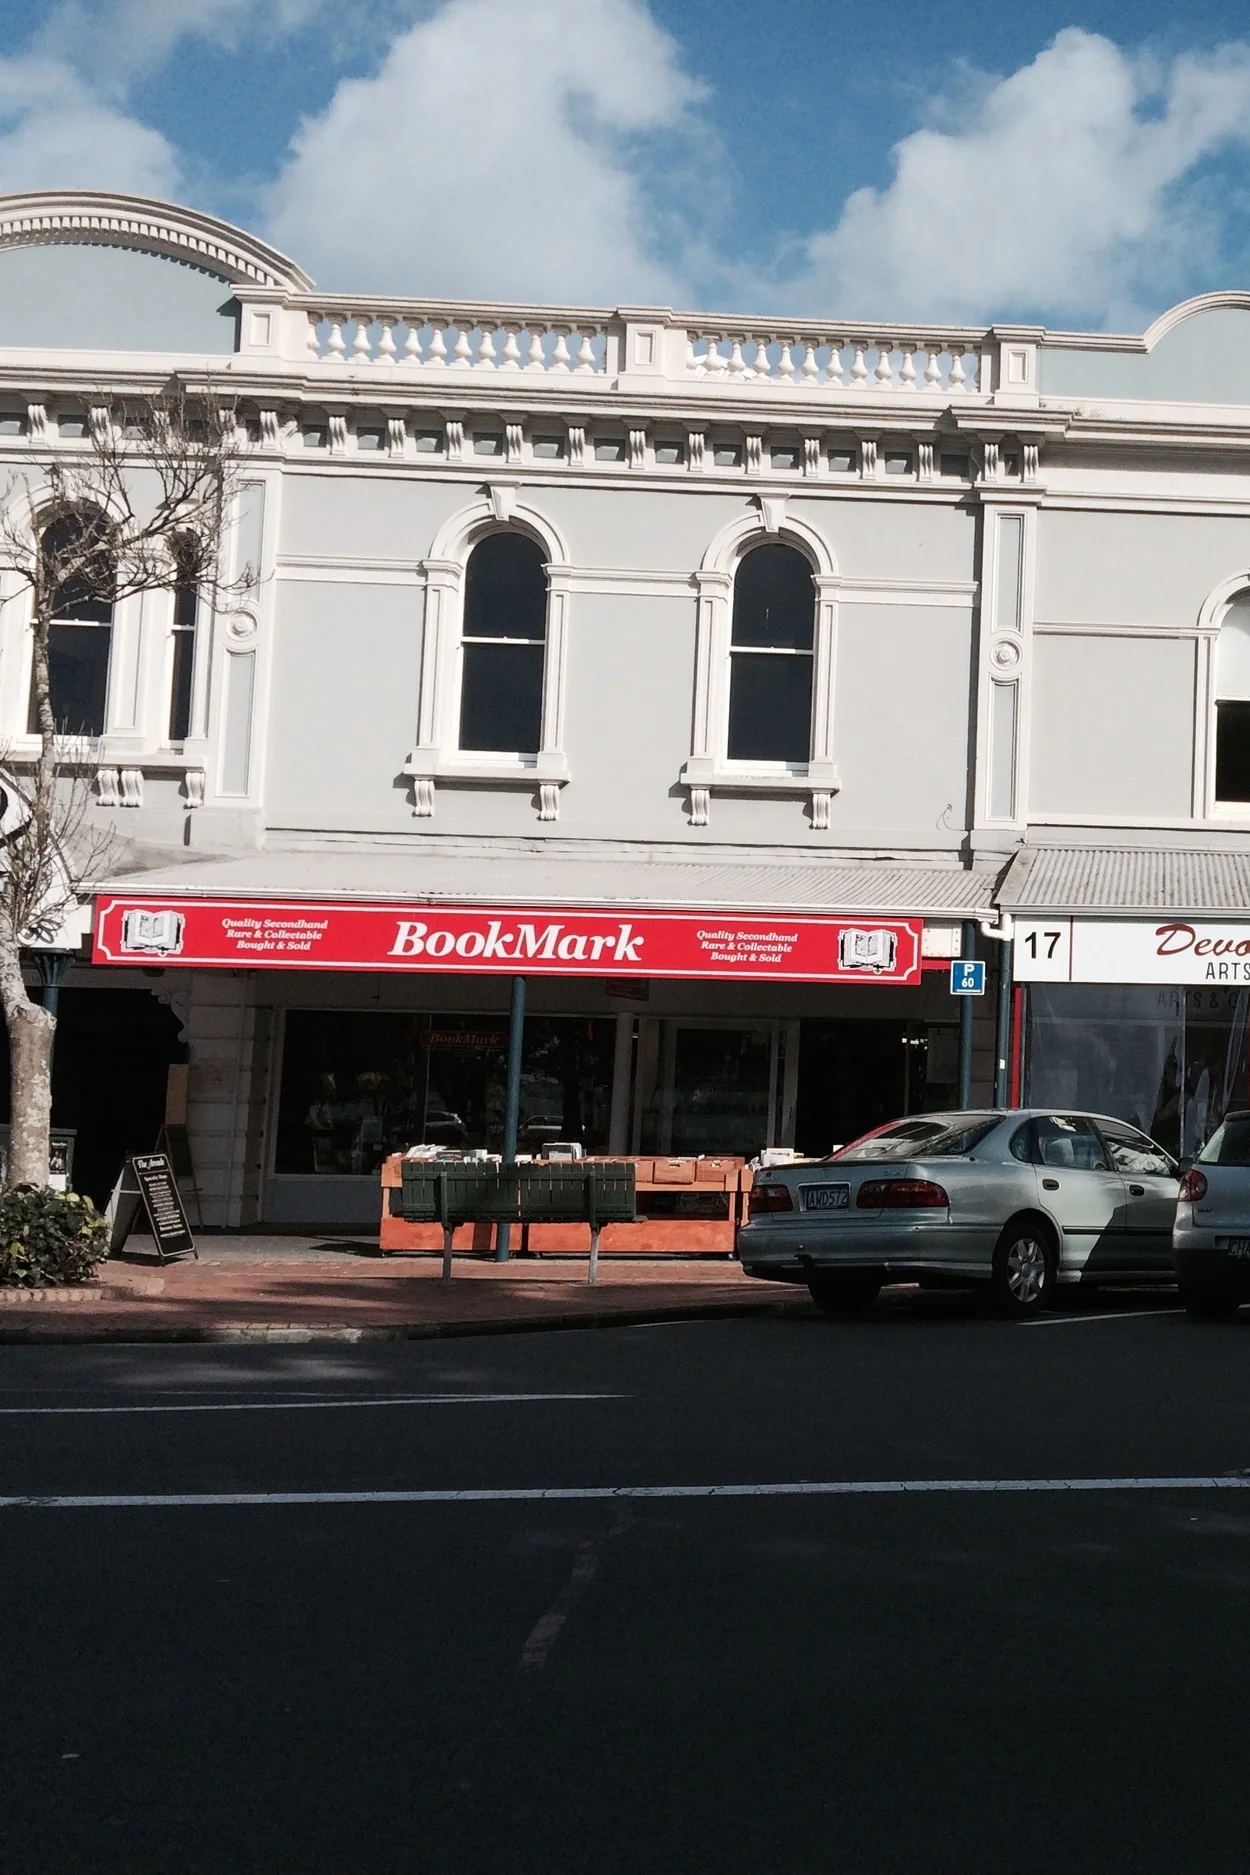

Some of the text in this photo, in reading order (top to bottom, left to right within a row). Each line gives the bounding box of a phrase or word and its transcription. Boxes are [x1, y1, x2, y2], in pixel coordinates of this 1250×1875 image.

[222, 918, 329, 930] Quality Secondhand
[226, 929, 322, 940] Rare & Collectable
[387, 920, 645, 961] BookMark
[697, 930, 799, 942] Quality Secondhand
[236, 940, 311, 951] Bought & Sold
[701, 941, 793, 952] Rare & Collectable
[1025, 931, 1061, 959] 17
[710, 952, 782, 963] Bought & Sold
[963, 963, 975, 977] P
[961, 977, 975, 988] 60
[808, 1189, 848, 1207] AWD572
